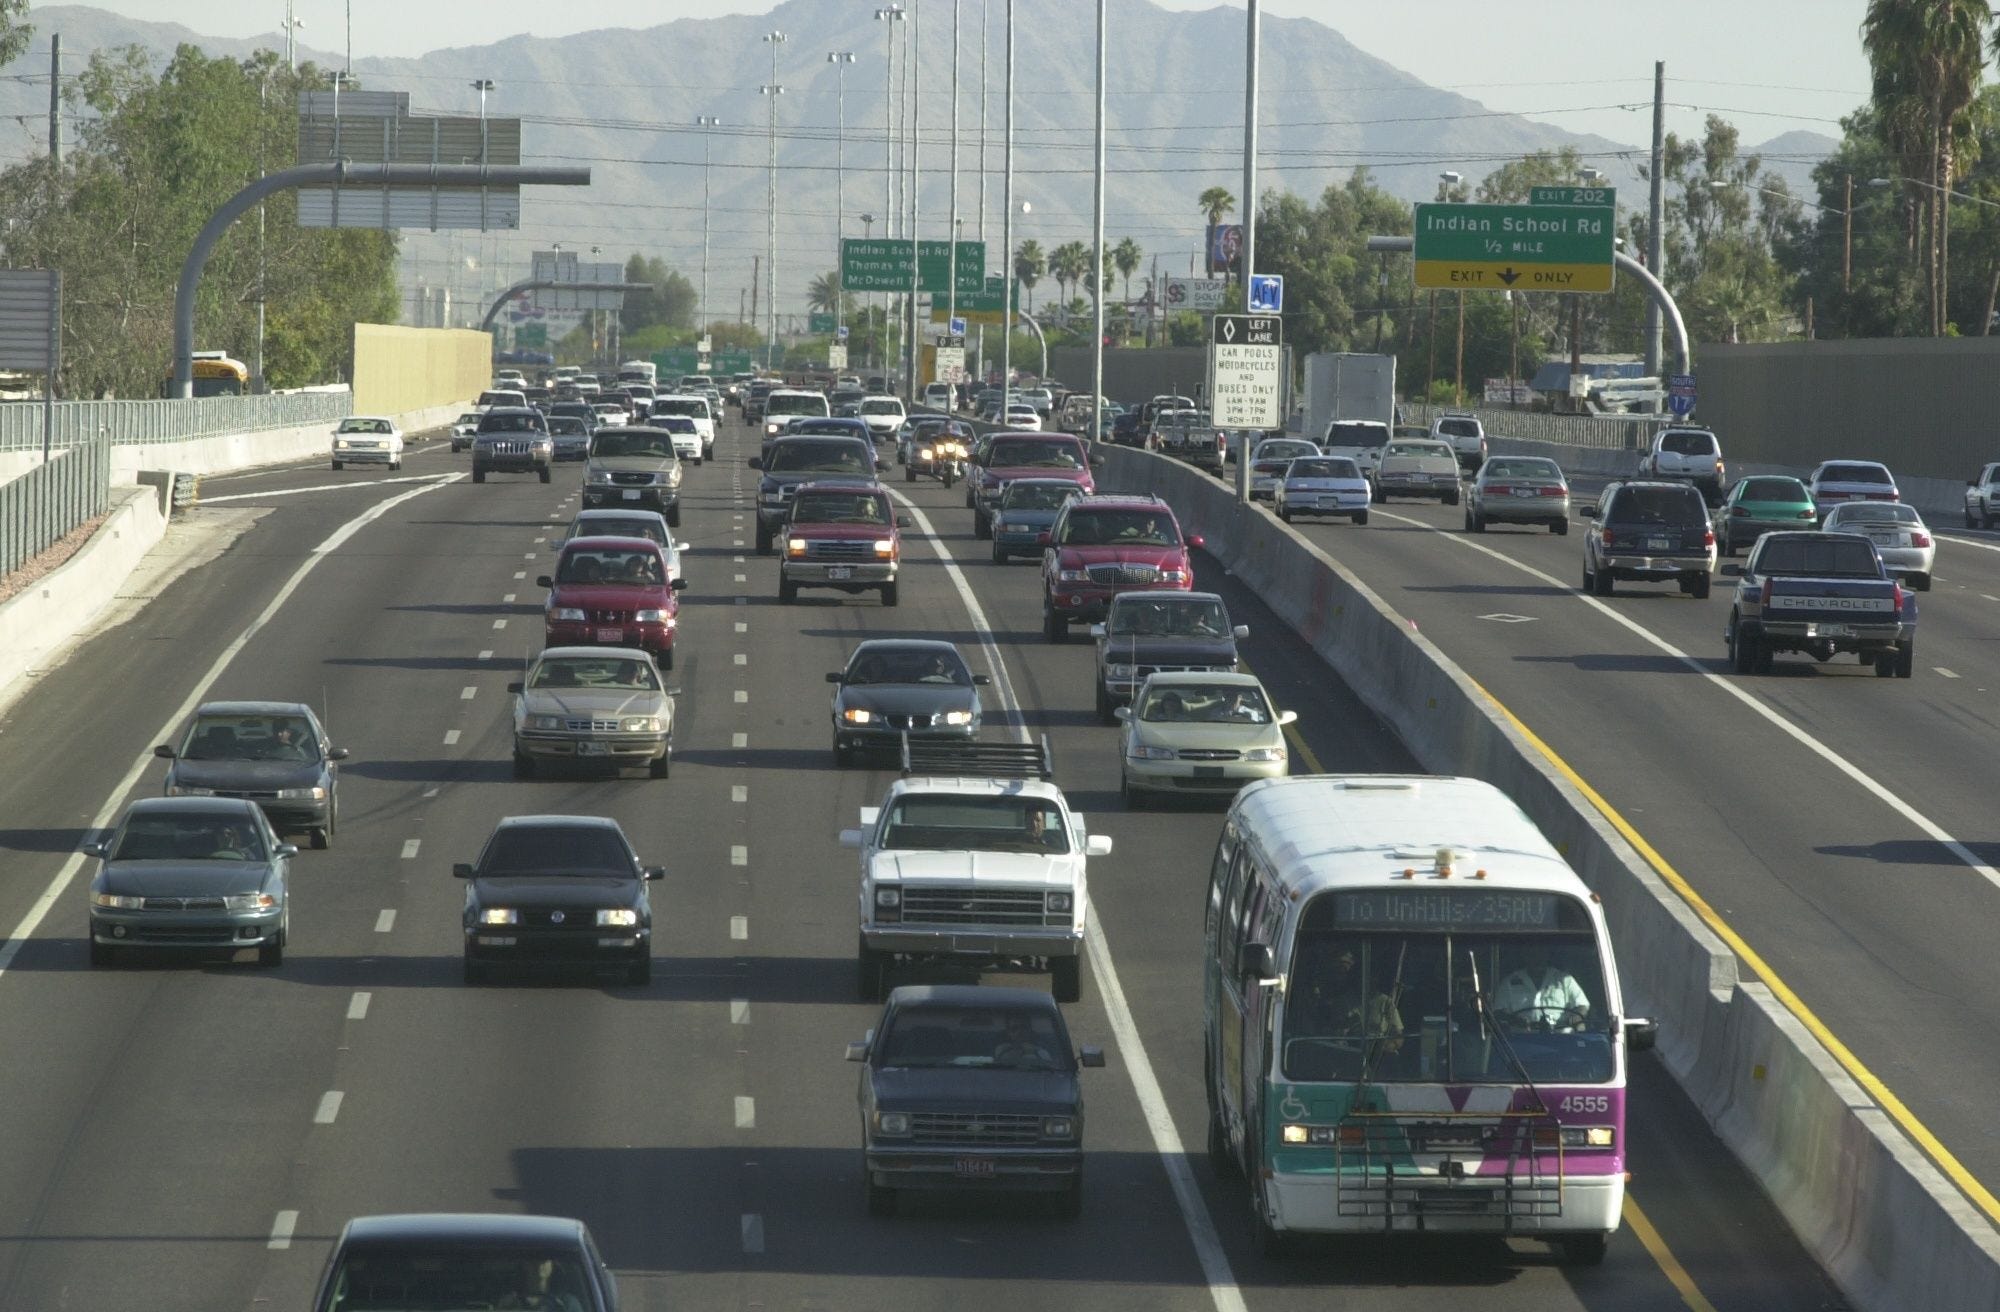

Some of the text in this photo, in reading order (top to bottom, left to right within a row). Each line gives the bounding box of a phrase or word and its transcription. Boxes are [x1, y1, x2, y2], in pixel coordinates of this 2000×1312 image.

[1538, 190, 1605, 204] EXIT 202
[1427, 214, 1602, 235] Indian School Rd
[849, 245, 886, 256] Indian
[890, 245, 930, 257] Schol
[934, 246, 950, 257] Rd
[1512, 241, 1544, 253] MILE
[849, 260, 894, 271] Thomas
[848, 274, 904, 286] McDowell
[1450, 270, 1574, 284] EXIT ONLY
[1248, 319, 1272, 330] LEFT
[1247, 331, 1273, 343] LANE
[1221, 347, 1273, 359] CAR POOLS
[1218, 359, 1276, 371] MOTORCYCLES
[1238, 373, 1255, 382] AND
[1218, 383, 1275, 395] BUSES ONLY
[1673, 395, 1690, 411] 17
[1783, 598, 1881, 609] CHEVROLET
[1346, 894, 1374, 921] To
[1560, 1095, 1609, 1113] 4555
